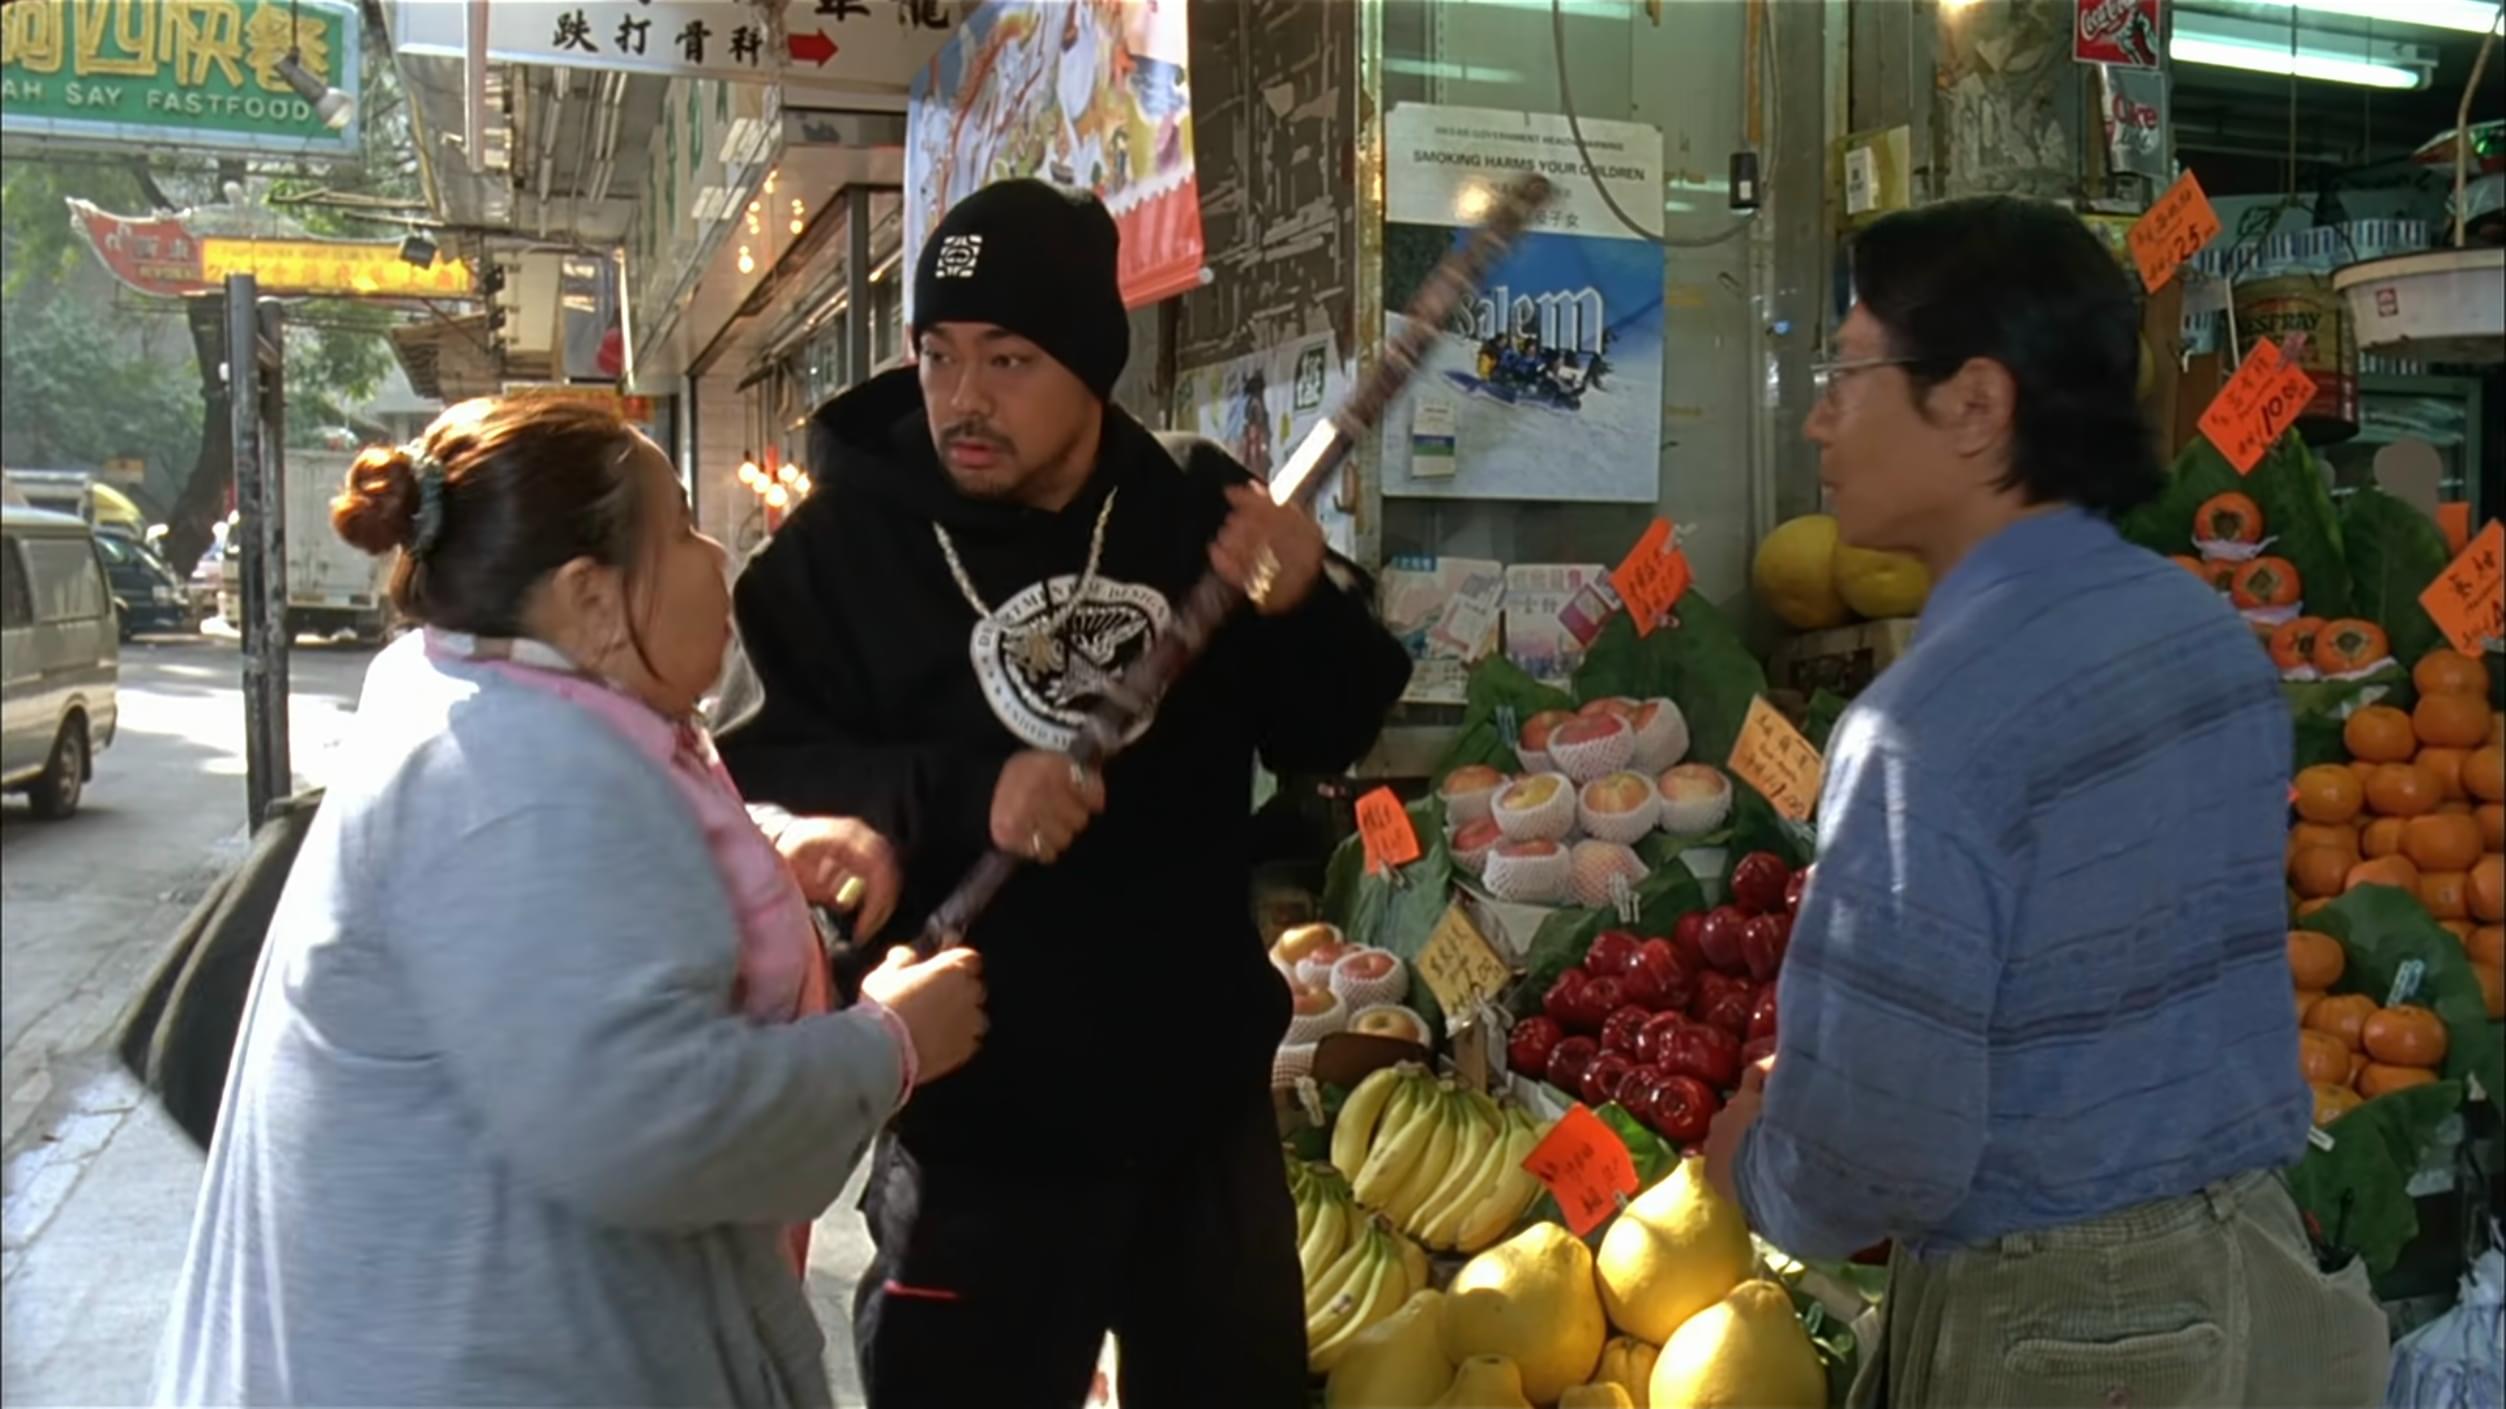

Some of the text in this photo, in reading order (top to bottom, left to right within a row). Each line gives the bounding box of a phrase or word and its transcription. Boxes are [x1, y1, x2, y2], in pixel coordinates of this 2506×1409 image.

[552, 8, 765, 68] 跌打骨科
[3, 78, 311, 121] AH SAY FASTFOOD
[1413, 149, 1481, 167] SMOKING
[1484, 153, 1536, 171] HARMS
[1538, 159, 1578, 176] YOUR
[1454, 285, 1605, 355] Salem
